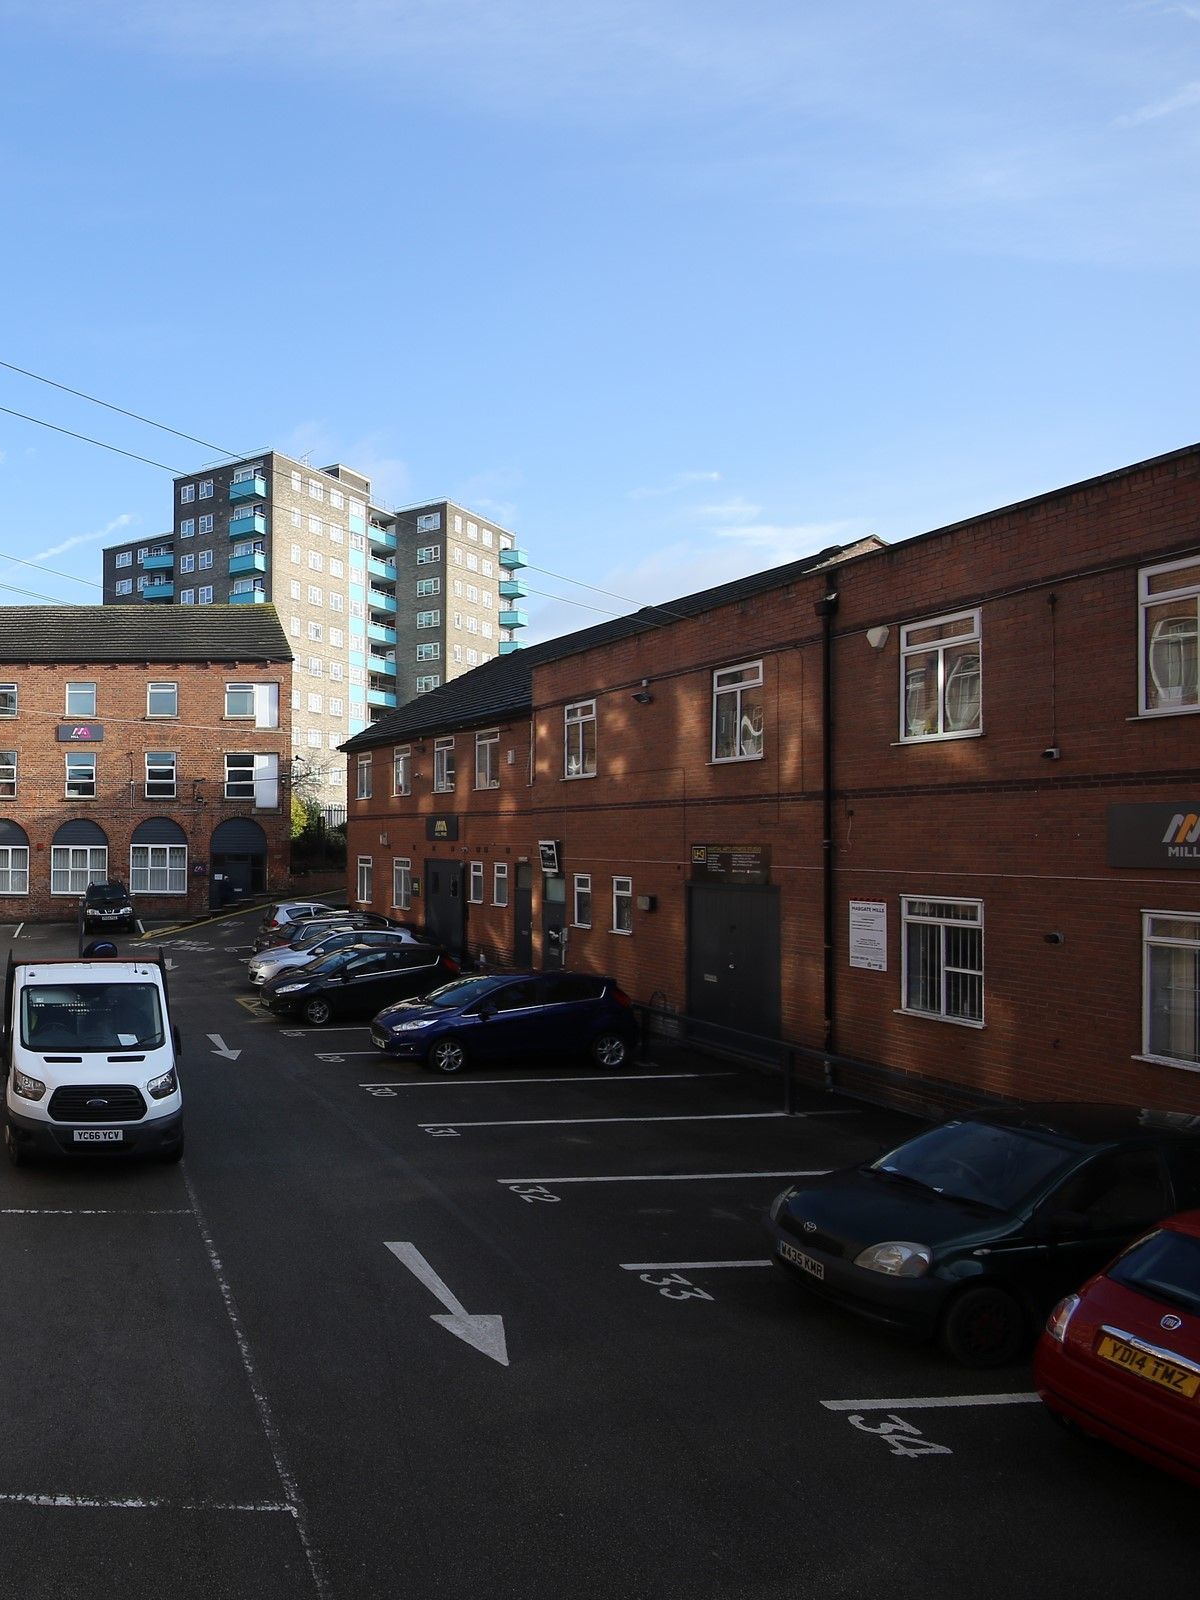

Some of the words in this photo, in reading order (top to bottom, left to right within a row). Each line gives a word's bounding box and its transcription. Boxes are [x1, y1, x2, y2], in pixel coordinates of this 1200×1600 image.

[366, 1087, 398, 1096] 30
[77, 1131, 101, 1140] YC66
[102, 1131, 120, 1140] YCV
[425, 1128, 461, 1136] 31
[509, 1185, 561, 1203] 32
[639, 1273, 714, 1300] 33
[1111, 1342, 1148, 1371] YD14
[1151, 1361, 1189, 1389] TMZ
[847, 1414, 953, 1458] 34
